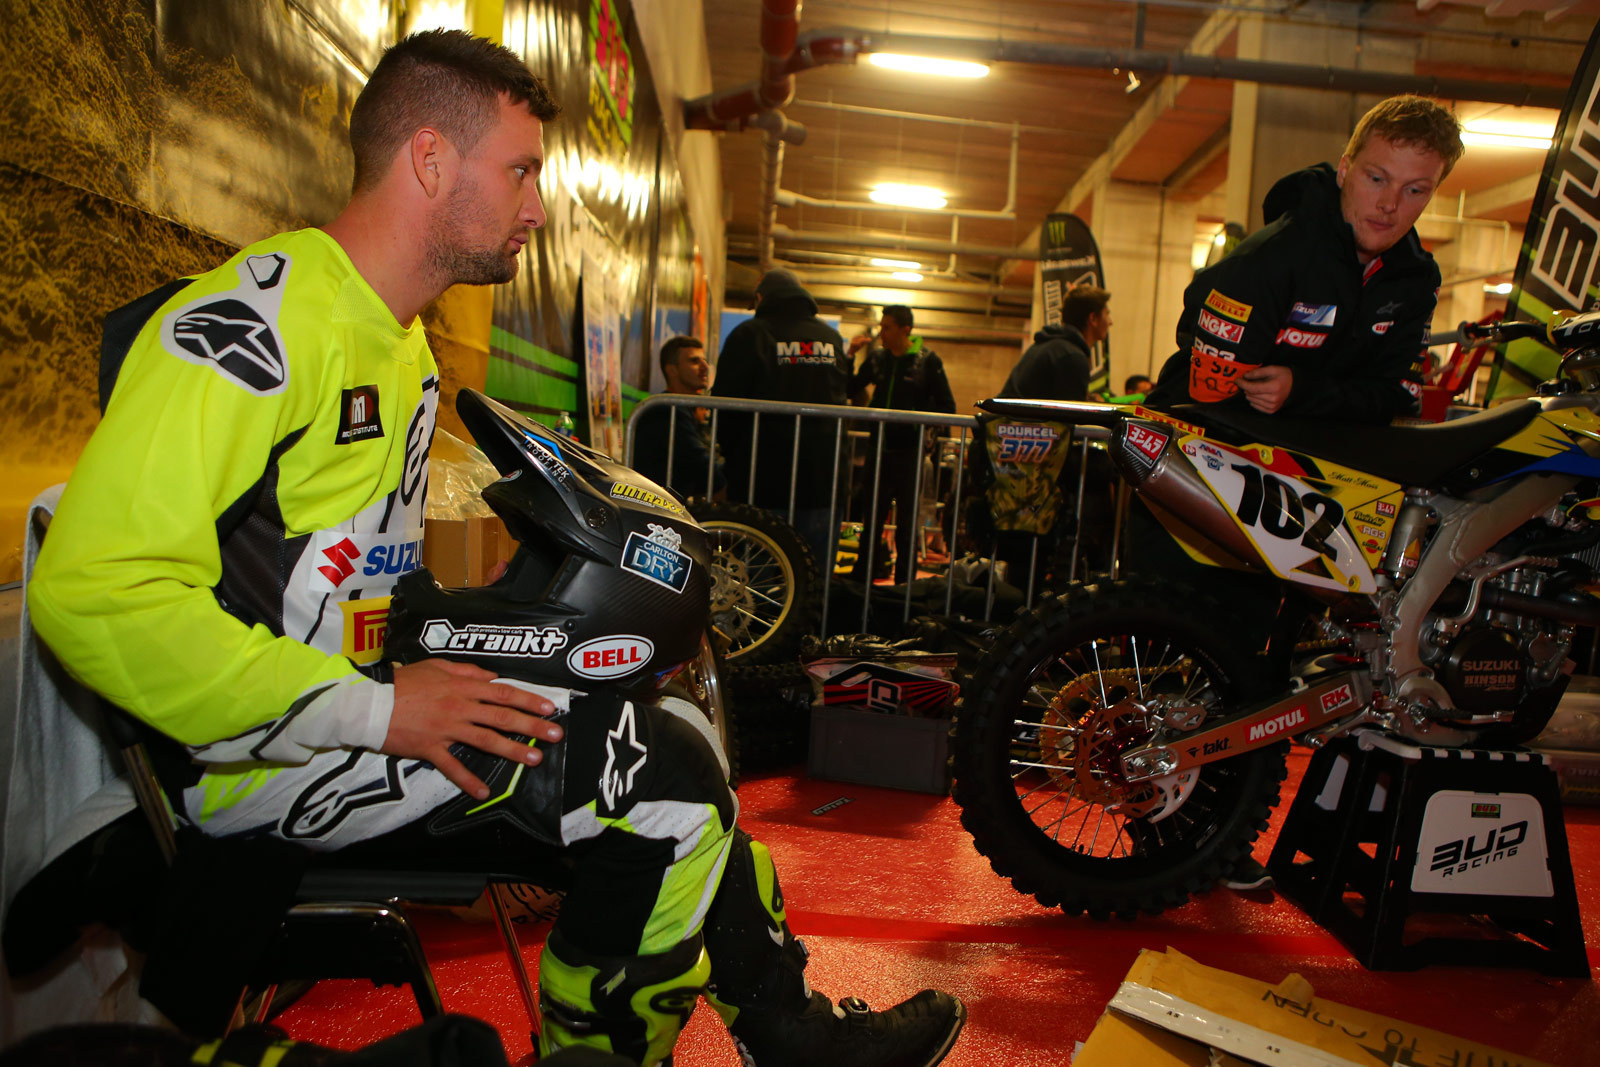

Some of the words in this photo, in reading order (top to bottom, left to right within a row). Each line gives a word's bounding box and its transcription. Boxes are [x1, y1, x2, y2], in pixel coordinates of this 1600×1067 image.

[1200, 313, 1232, 339] NGK
[776, 341, 835, 357] MXM
[997, 425, 1059, 438] POURCEL
[997, 438, 1053, 462] 377
[553, 456, 570, 479] TEK
[1231, 463, 1345, 563] 102
[643, 542, 680, 564] CARLTON
[630, 547, 684, 584] DRY
[582, 646, 642, 669] BELL
[1463, 660, 1519, 672] SUZUKI
[1464, 674, 1517, 685] HINSON
[1321, 685, 1351, 710] RK
[1249, 708, 1305, 742] MOTUL
[1202, 737, 1230, 757] takt
[1430, 820, 1528, 872] BUD
